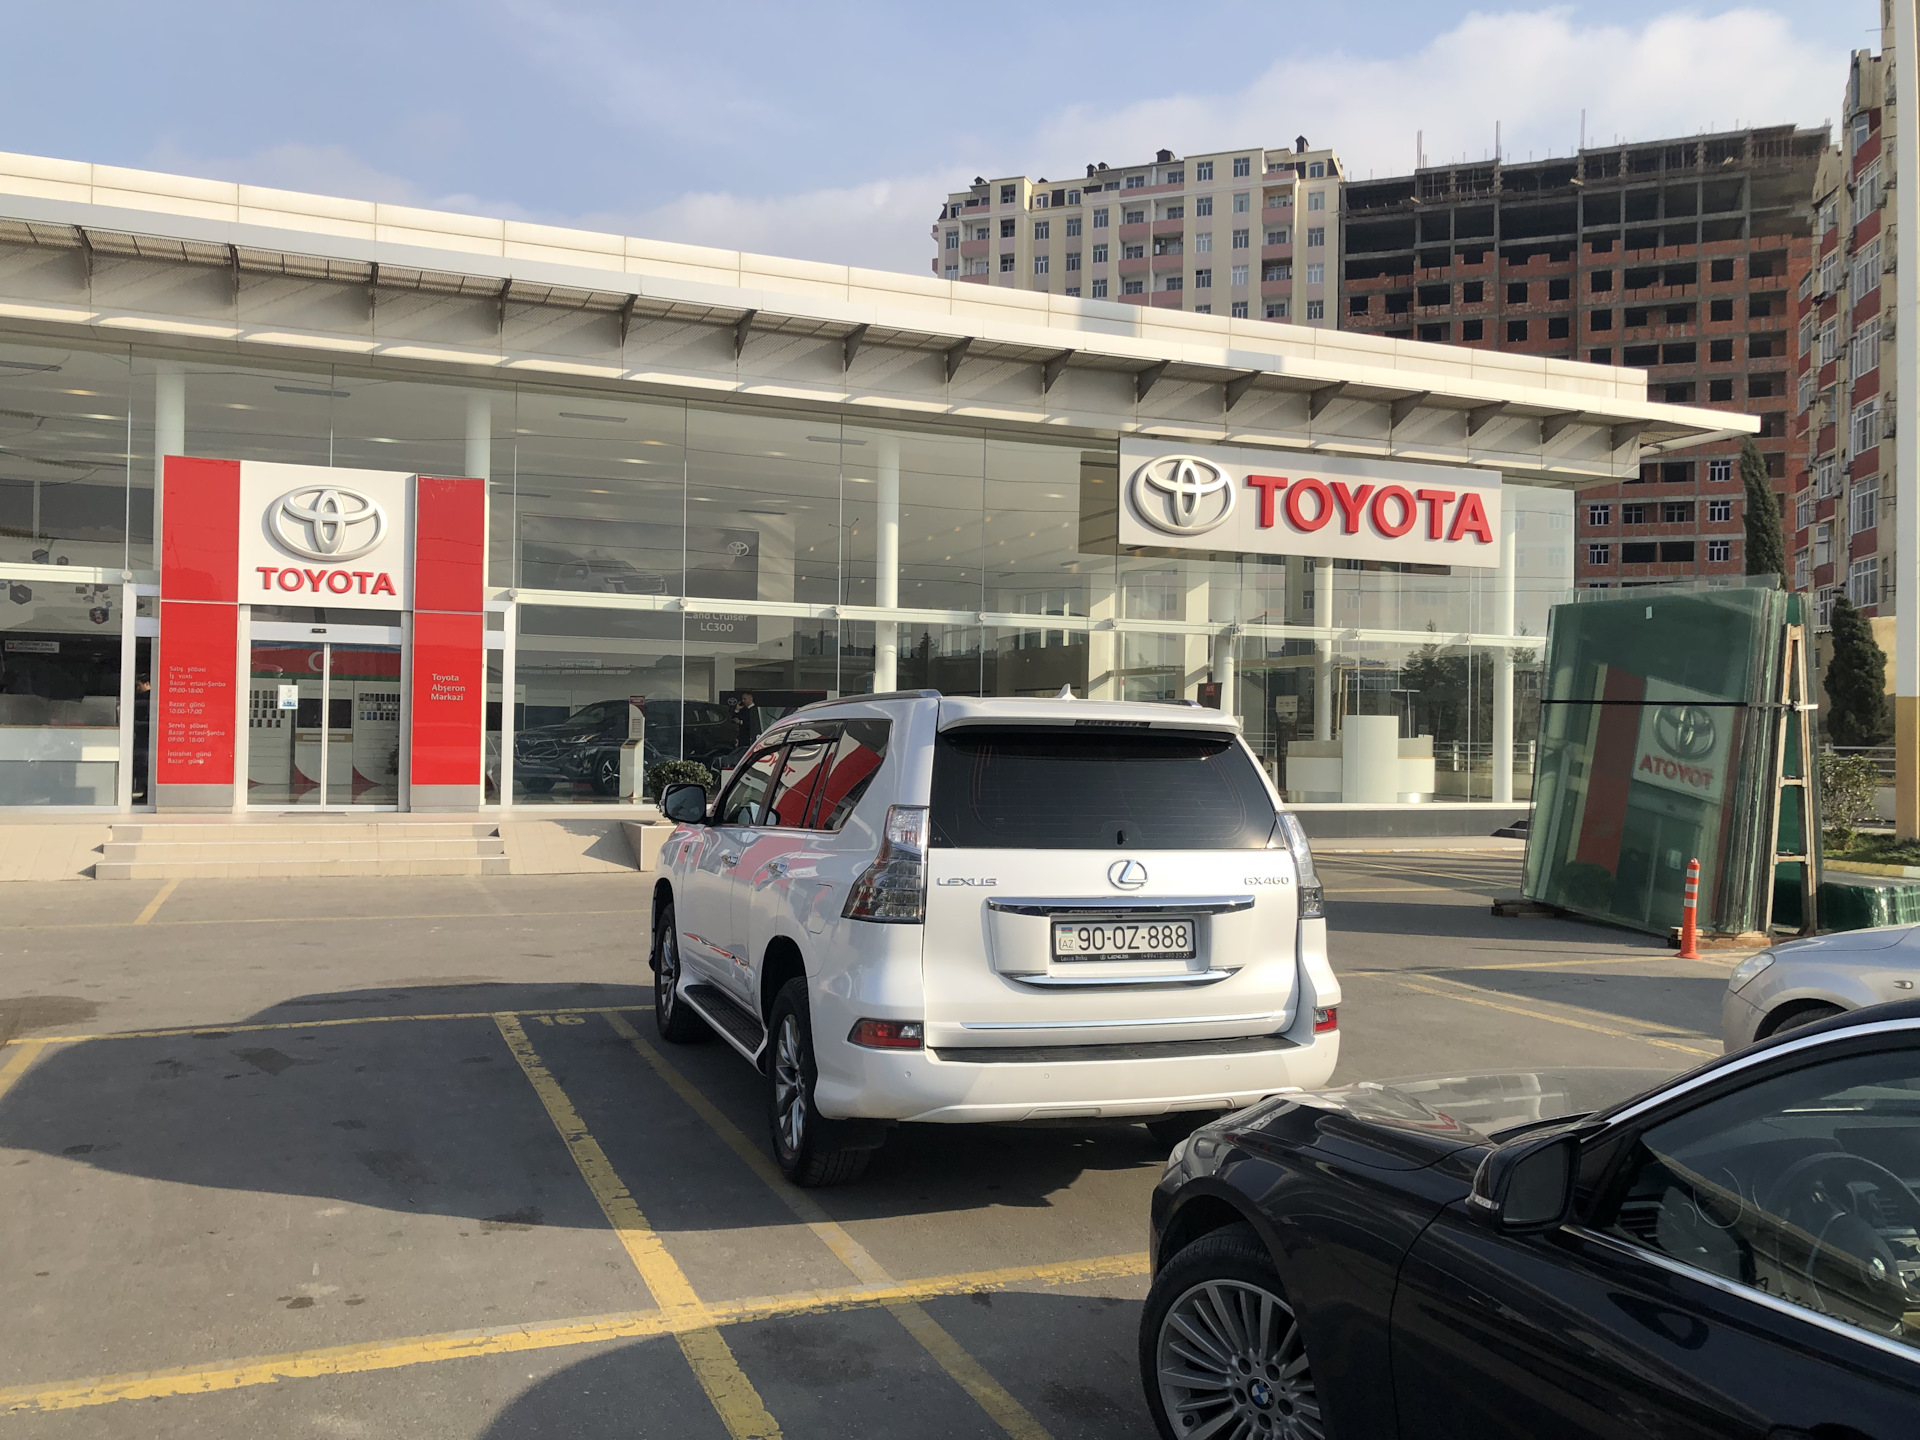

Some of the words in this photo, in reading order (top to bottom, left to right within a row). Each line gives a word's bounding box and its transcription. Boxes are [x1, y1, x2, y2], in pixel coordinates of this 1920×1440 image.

[1247, 474, 1493, 544] TOYOTA
[256, 566, 397, 596] TOYOTA
[700, 622, 734, 632] LC300
[431, 673, 460, 682] Toyota
[431, 684, 466, 692] Abşeron
[936, 877, 998, 886] LEXUS
[1061, 940, 1074, 949] AZ
[1078, 925, 1188, 951] 90-OZ-888
